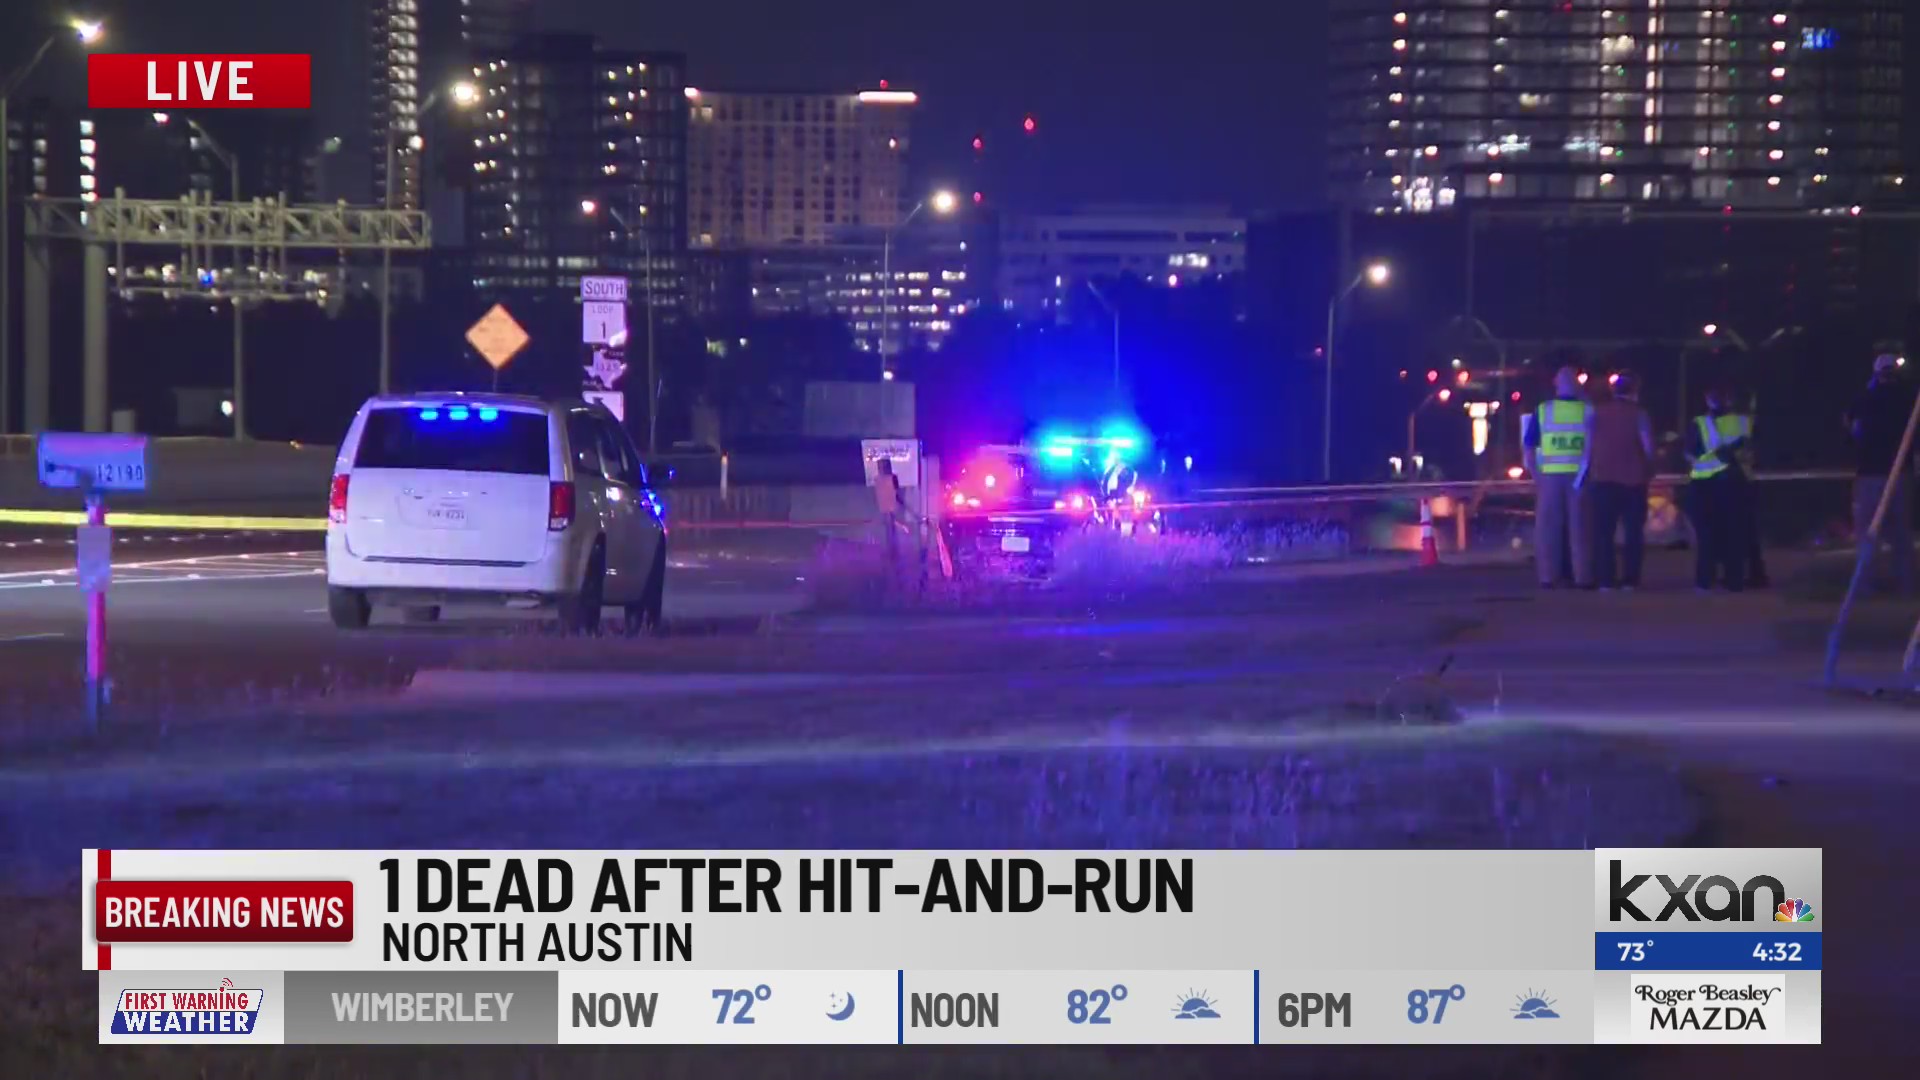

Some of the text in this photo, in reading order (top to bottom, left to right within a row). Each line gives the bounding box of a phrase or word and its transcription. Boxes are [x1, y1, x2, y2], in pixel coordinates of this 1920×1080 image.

[584, 280, 624, 296] SOUTH
[600, 321, 607, 340] 1
[97, 463, 143, 482] 12190
